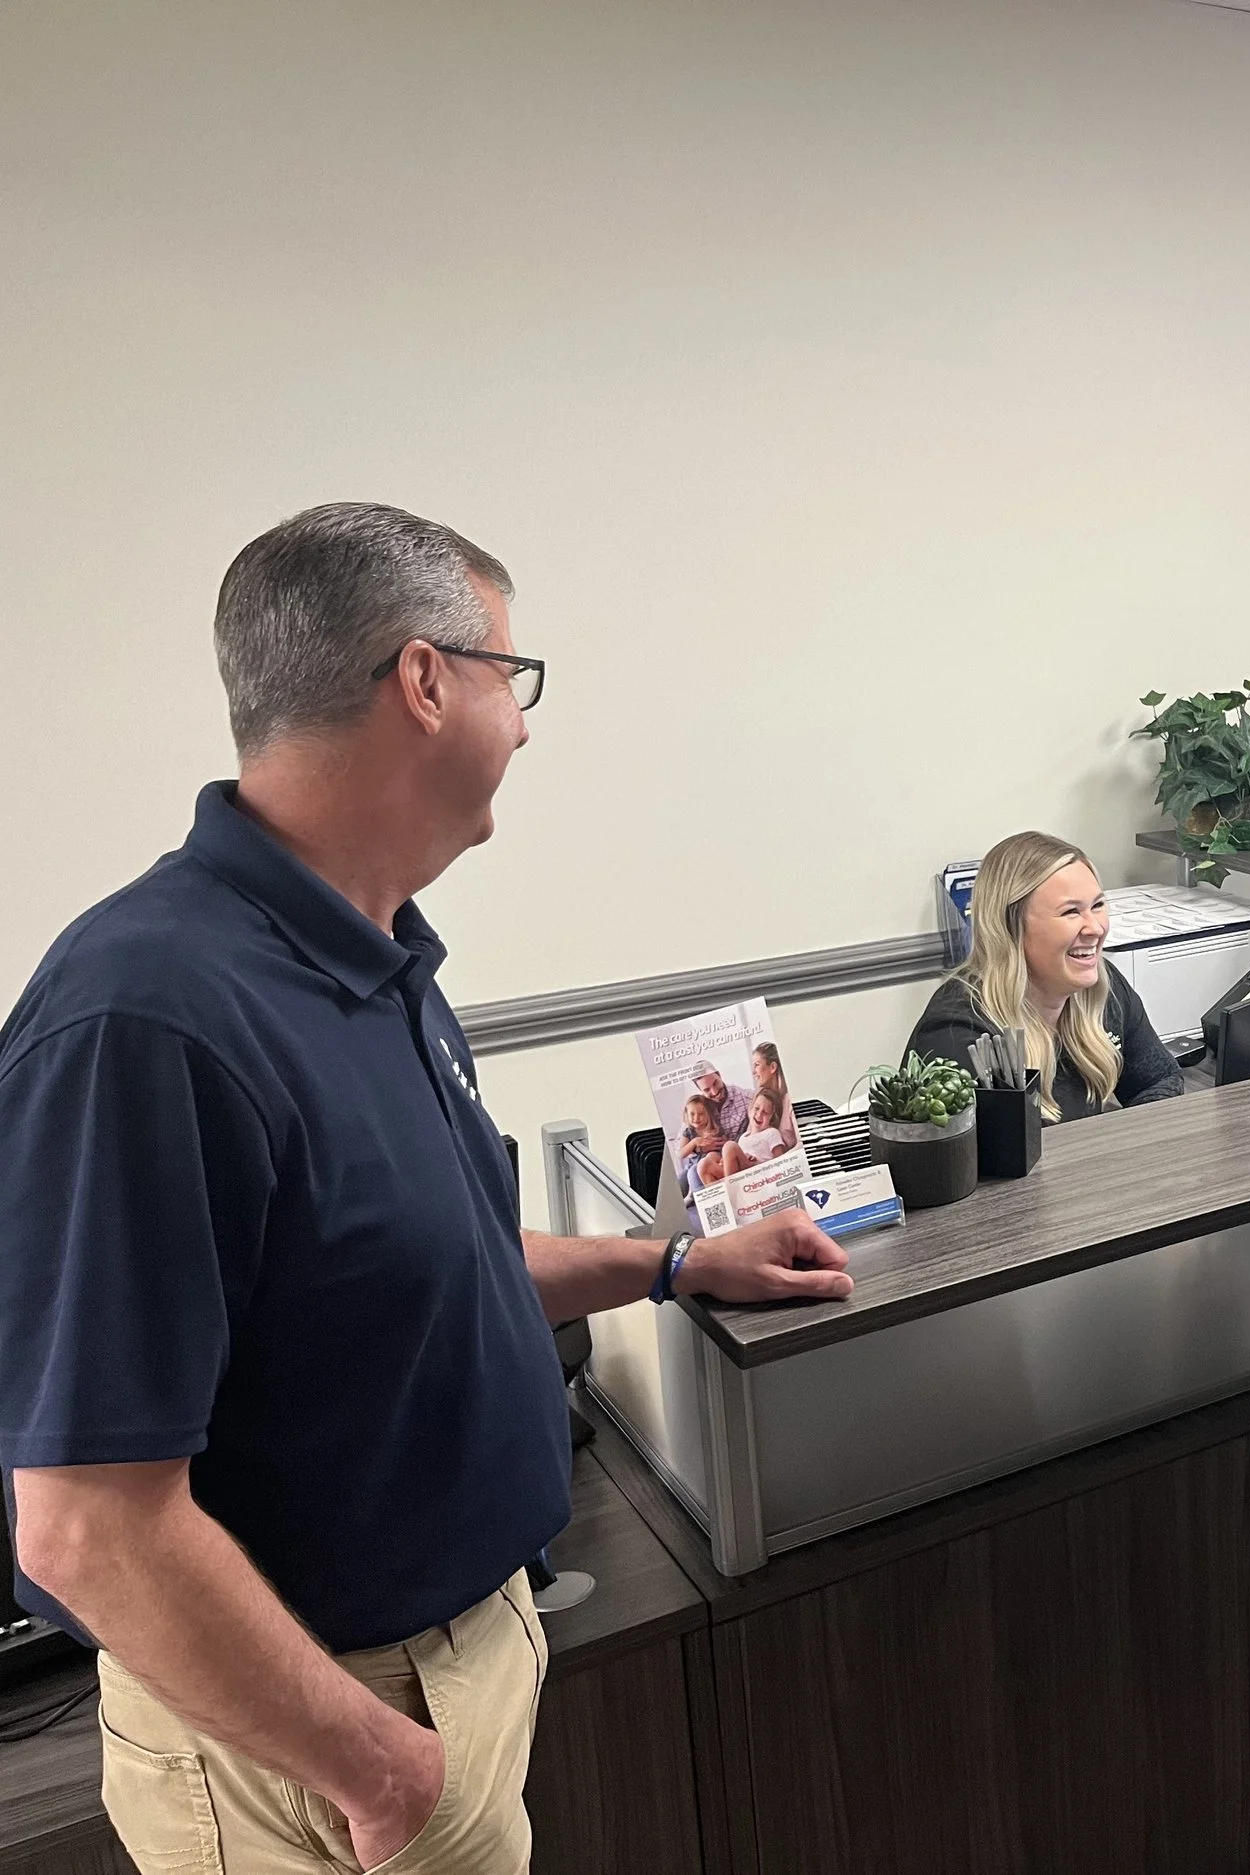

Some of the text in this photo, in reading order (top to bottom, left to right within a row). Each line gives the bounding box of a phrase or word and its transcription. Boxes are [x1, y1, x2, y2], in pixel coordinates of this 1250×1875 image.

[648, 1014, 737, 1051] The care you need
[653, 1051, 666, 1066] at
[666, 1051, 674, 1062] a
[674, 1043, 696, 1059] cost
[696, 1040, 715, 1055] you
[716, 1031, 734, 1046] can
